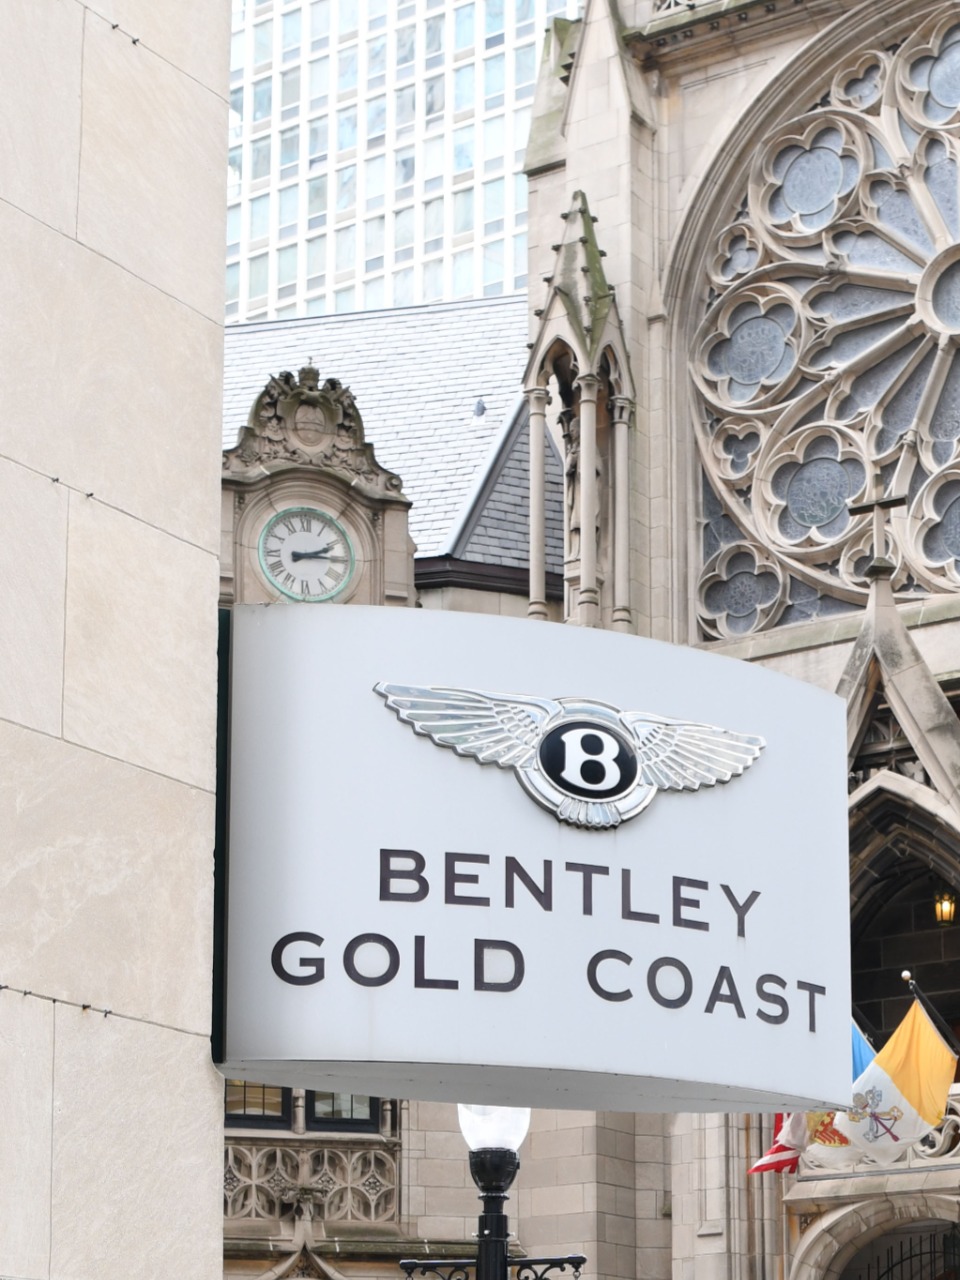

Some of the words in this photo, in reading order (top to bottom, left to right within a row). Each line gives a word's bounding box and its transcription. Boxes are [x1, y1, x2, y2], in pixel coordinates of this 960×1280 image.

[559, 727, 622, 792] B
[379, 848, 762, 939] BENTLEY
[270, 931, 525, 993] GOLD
[586, 949, 827, 1033] COAST
